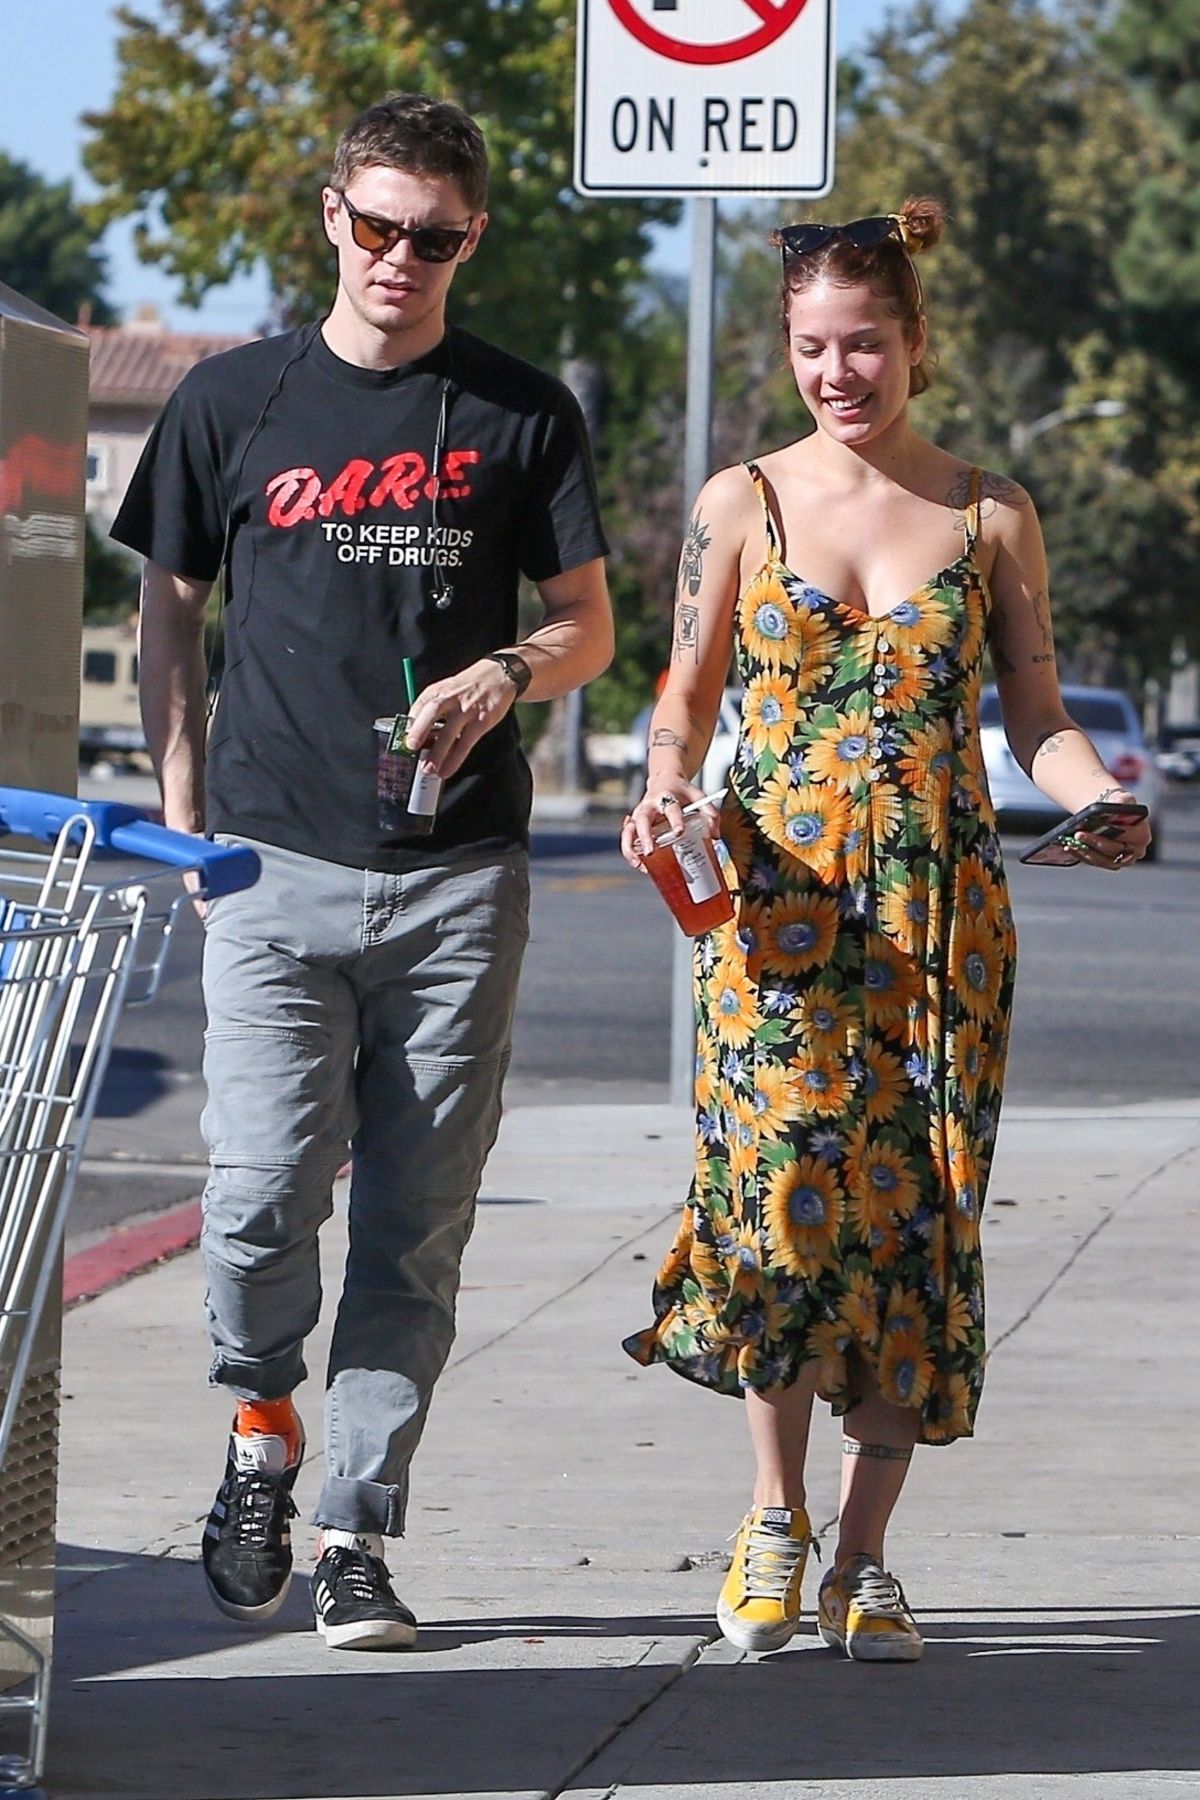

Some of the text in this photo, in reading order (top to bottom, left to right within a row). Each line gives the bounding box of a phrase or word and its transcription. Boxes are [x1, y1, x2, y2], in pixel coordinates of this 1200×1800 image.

[612, 97, 799, 153] ON RED
[321, 522, 474, 549] TO KEEP KIDS
[337, 544, 464, 567] OFF DRUGS.
